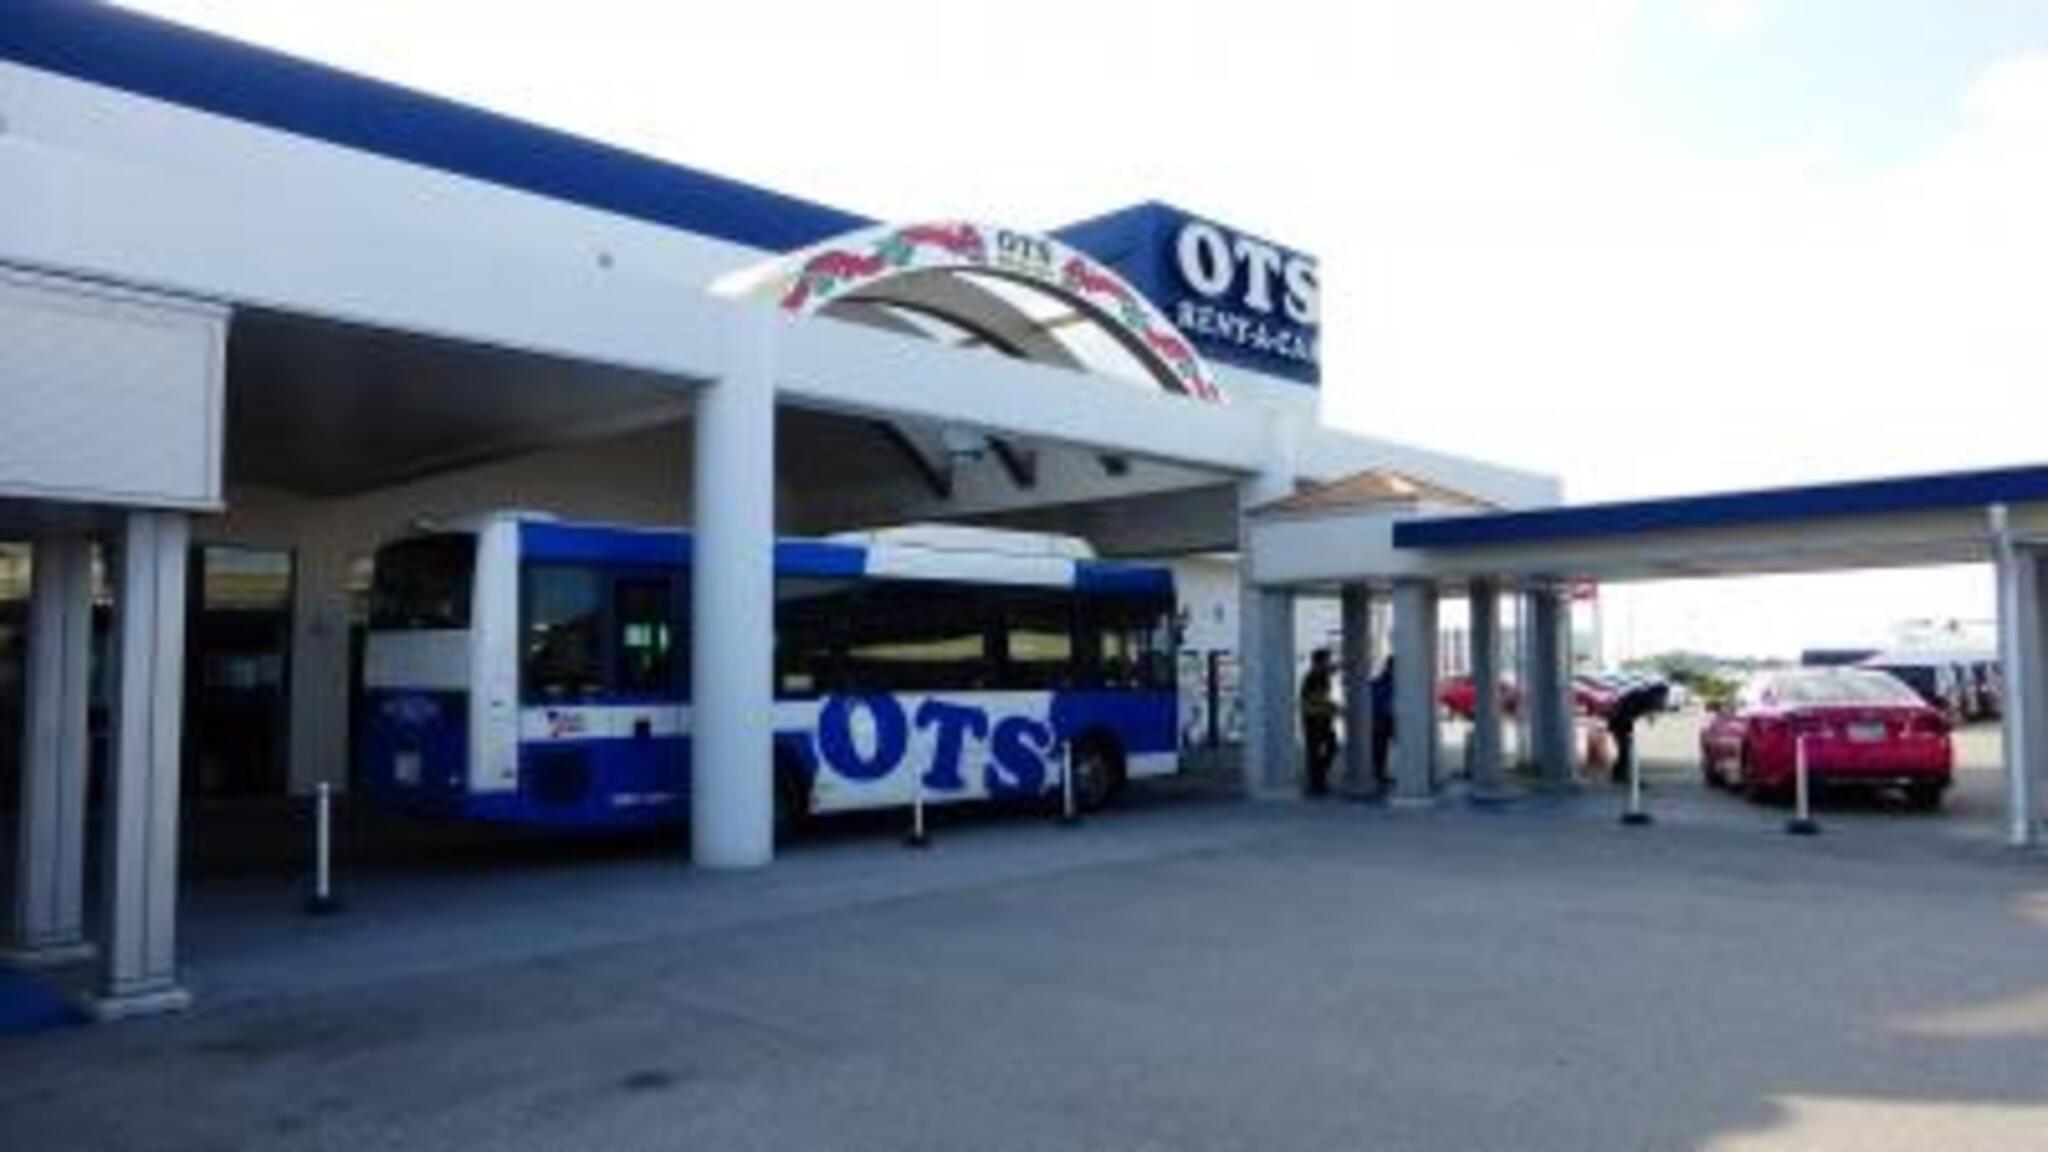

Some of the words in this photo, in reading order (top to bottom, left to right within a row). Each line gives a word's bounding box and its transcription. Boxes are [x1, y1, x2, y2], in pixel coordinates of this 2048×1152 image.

[998, 229, 1051, 265] OTS
[1177, 221, 1320, 324] OTS
[818, 690, 1054, 796] OTS
